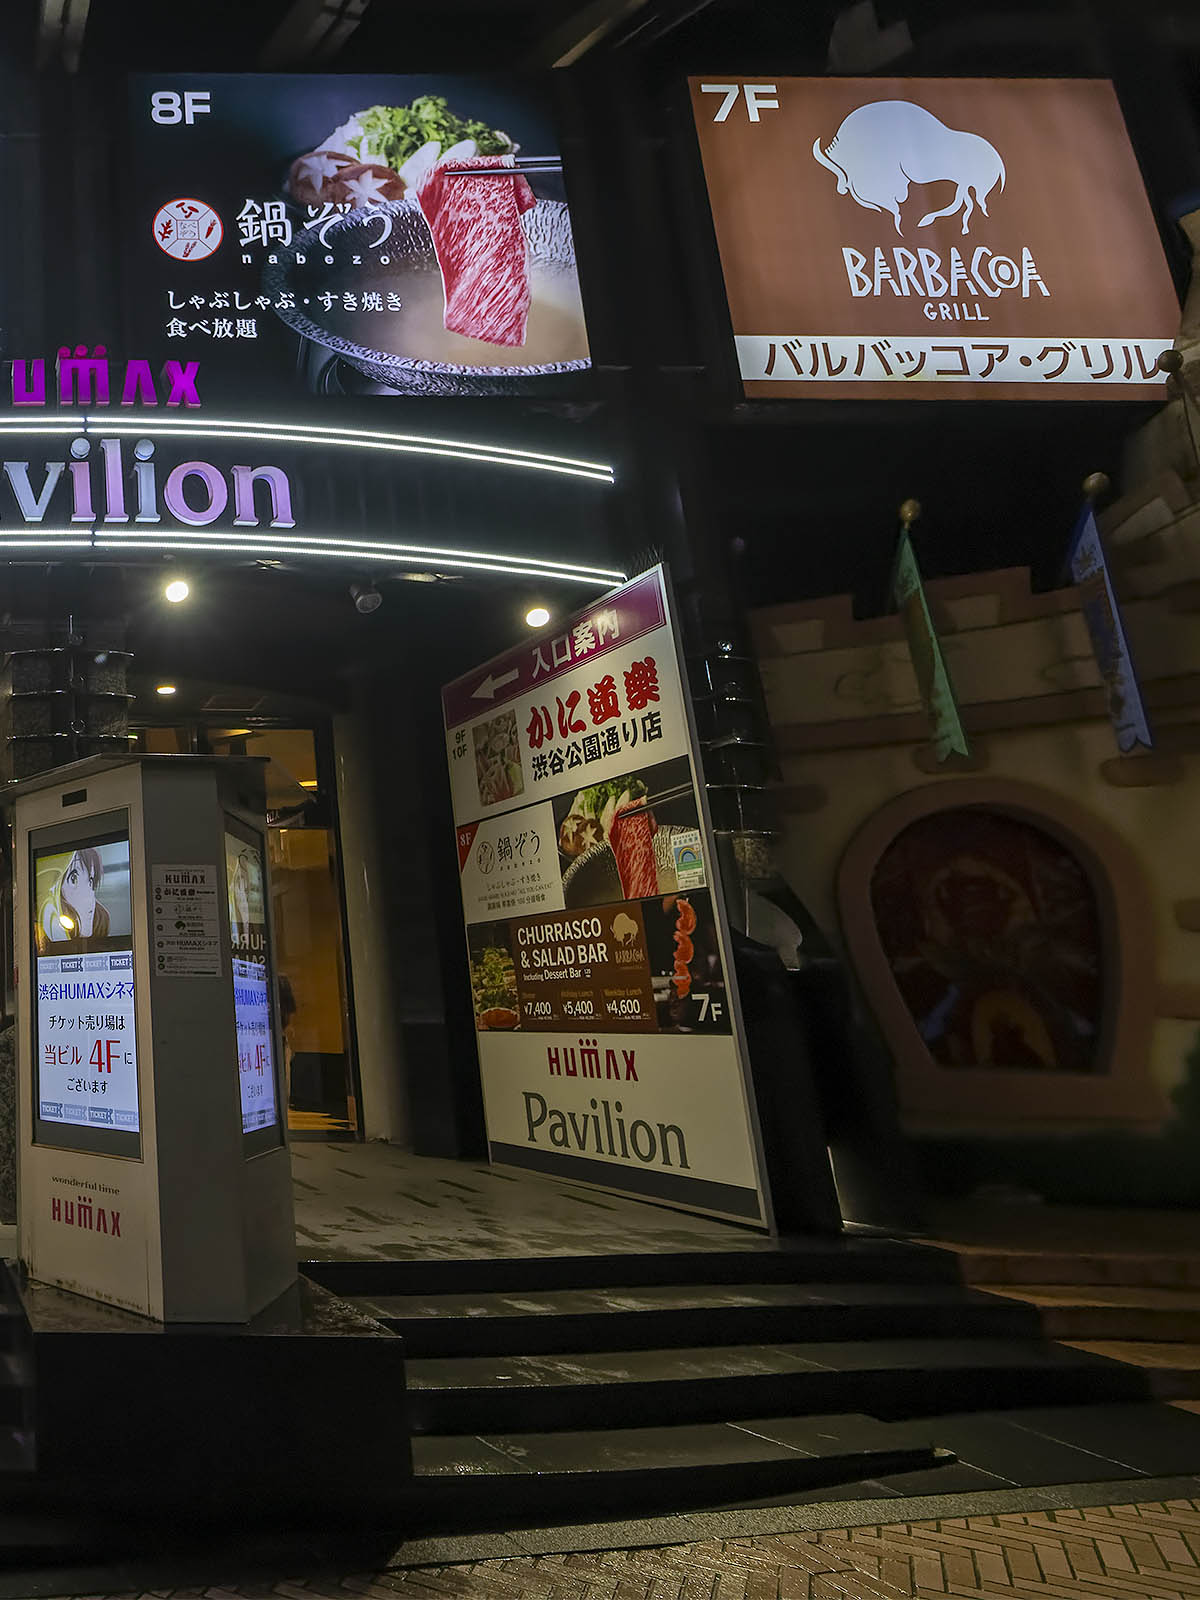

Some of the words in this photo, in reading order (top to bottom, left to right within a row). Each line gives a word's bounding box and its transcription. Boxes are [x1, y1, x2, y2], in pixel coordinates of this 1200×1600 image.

[150, 91, 211, 125] 8F
[700, 83, 780, 122] 7F
[236, 198, 394, 250] 鍋ぞう
[241, 252, 391, 266] nabezo
[842, 246, 1051, 298] BARBACOA
[166, 289, 403, 313] しゃぶしゃぶ・すき焼き
[922, 302, 991, 322] GRILL
[165, 317, 259, 340] 食べ放題
[763, 338, 1163, 381] バルバッコア・グリル
[530, 607, 621, 680] 入口案内
[454, 728, 466, 744] 9F
[531, 710, 664, 782] 渋谷公園通り店
[452, 744, 468, 761] 10F
[459, 831, 472, 847] 8F
[497, 829, 541, 863] 鍋ぞう
[517, 916, 603, 947] CHURRASCO
[61, 961, 79, 970] TICKET
[111, 958, 130, 968] TICKET
[519, 949, 531, 970] &
[531, 945, 575, 969] SALAD
[577, 942, 609, 965] BAR
[543, 967, 569, 981] Dessert
[569, 967, 582, 980] Bar
[38, 981, 135, 1001] 渋谷HUMAXシネマ
[523, 1001, 552, 1017] ¥7,400
[562, 1000, 594, 1017] ¥5,400
[606, 998, 641, 1016] ¥4,600
[691, 993, 723, 1022] 7F
[49, 1014, 127, 1031] チケット売り場は
[44, 1043, 83, 1066] 当ビル
[89, 1039, 121, 1074] 4F
[124, 1052, 133, 1065] に
[67, 1077, 109, 1094] ございます
[522, 1091, 692, 1170] Pavilion
[51, 1176, 97, 1191] wonderful
[98, 1183, 121, 1195] time
